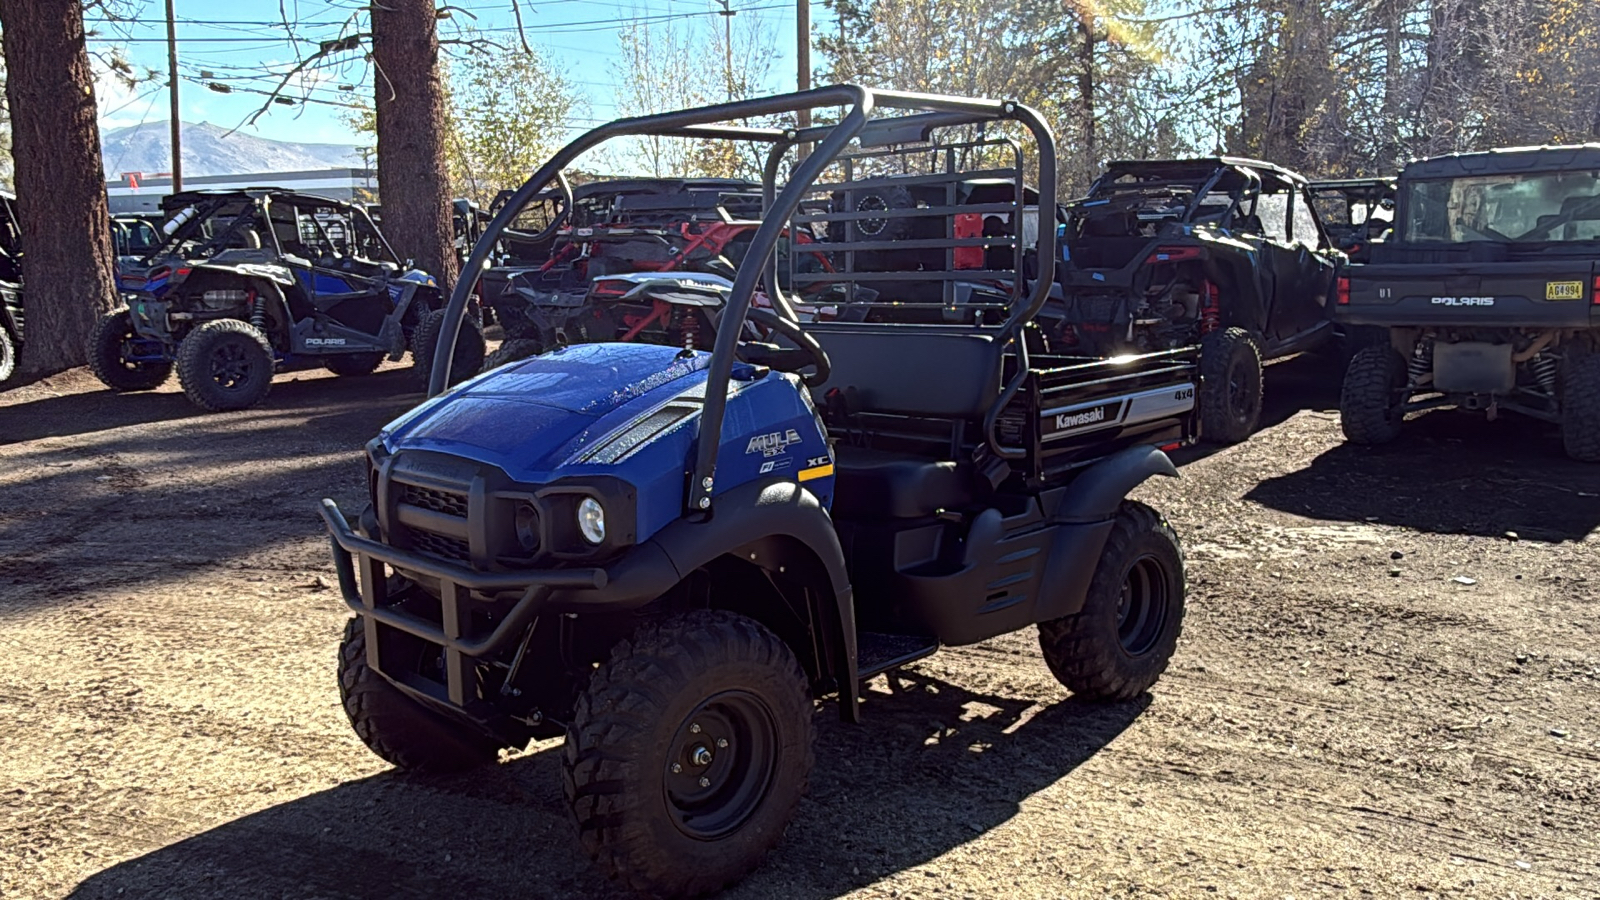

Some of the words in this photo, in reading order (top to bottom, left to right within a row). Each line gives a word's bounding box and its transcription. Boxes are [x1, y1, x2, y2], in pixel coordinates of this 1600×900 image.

[1548, 285, 1580, 296] AG4994
[1431, 297, 1494, 306] POLARIS
[1174, 388, 1193, 401] 4x4
[1056, 406, 1104, 429] Kawasaki
[745, 429, 802, 454] MULE
[763, 445, 786, 458] SX
[807, 455, 829, 467] XC
